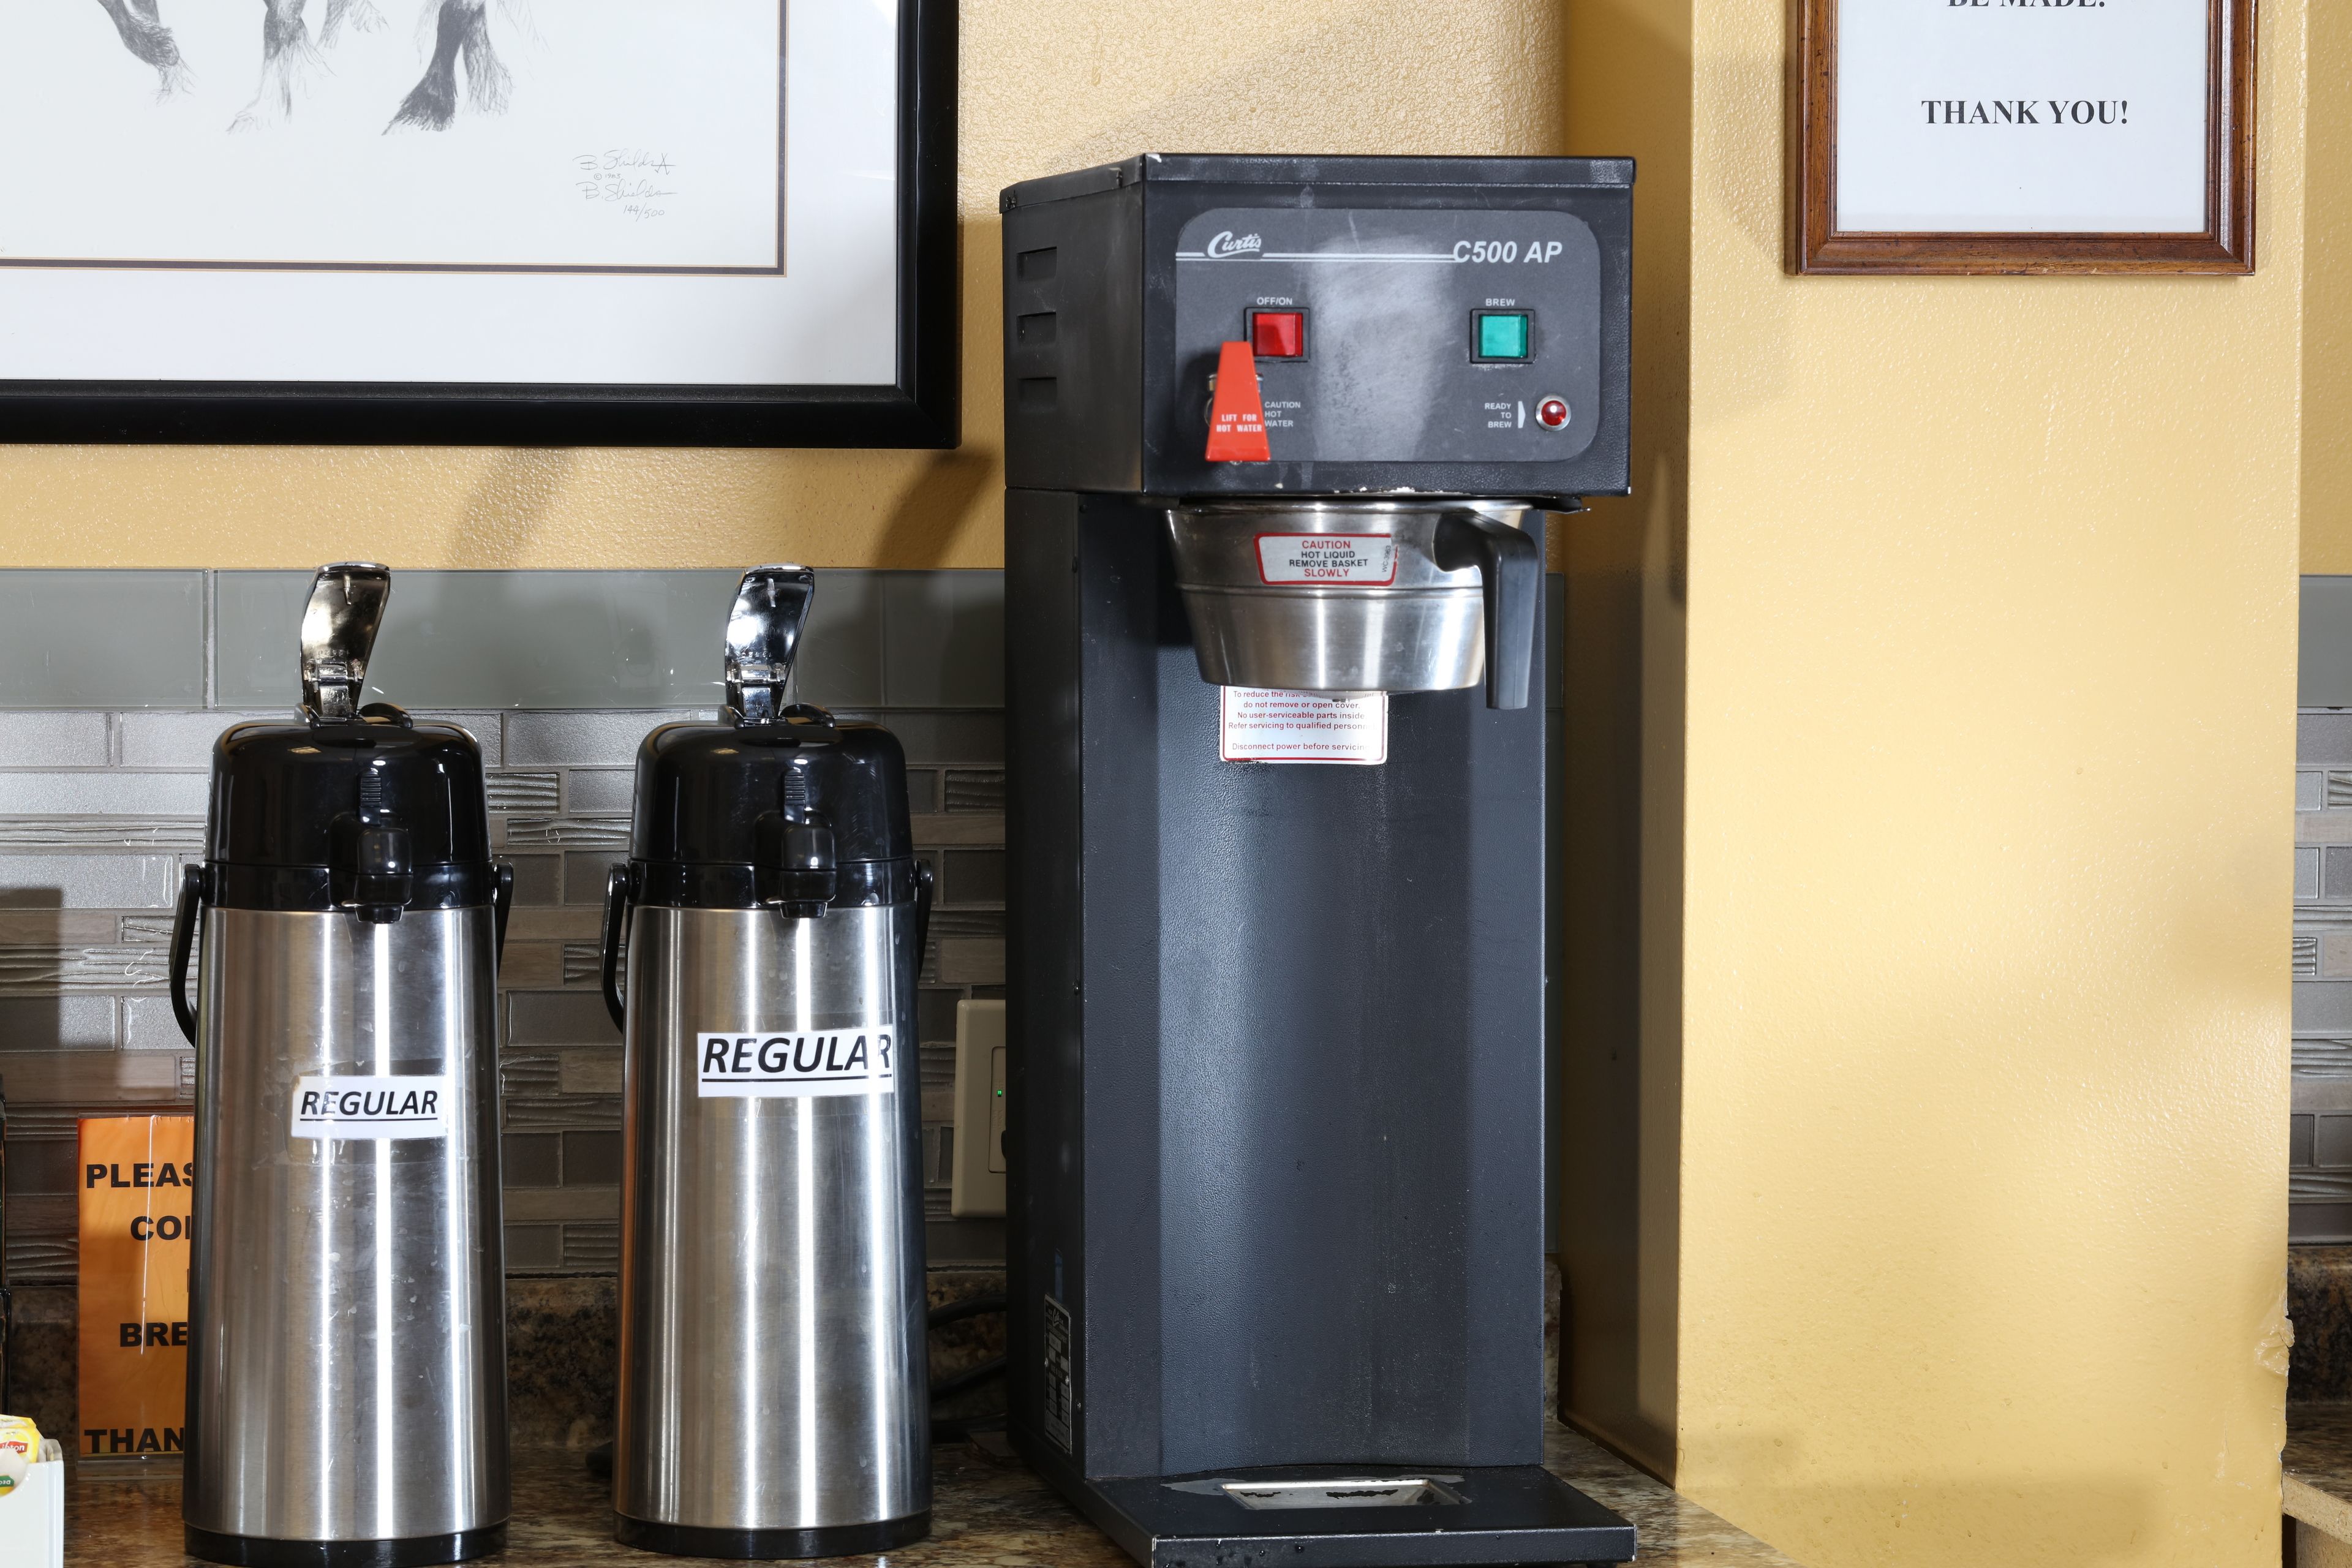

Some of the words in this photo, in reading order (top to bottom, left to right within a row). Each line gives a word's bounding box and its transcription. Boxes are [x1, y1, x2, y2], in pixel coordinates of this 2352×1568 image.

[1921, 100, 2041, 124] THANK
[2047, 100, 2128, 124] YOU!
[1207, 230, 1262, 258] Curtis
[1453, 240, 1518, 263] C500
[1523, 241, 1562, 263] AP
[1256, 296, 1293, 306] OFF/ON
[1485, 298, 1515, 306] BREW
[1242, 413, 1257, 422] FOR
[1236, 424, 1262, 432] WATER
[1302, 540, 1351, 549] CAUTION
[1324, 551, 1355, 559] LIQUID
[1332, 559, 1368, 567] BASKET
[1304, 568, 1350, 577] SLOWLY
[1316, 712, 1337, 720] parts
[1249, 722, 1284, 731] servicing
[1296, 722, 1332, 731] qualified
[1276, 744, 1301, 753] power
[1303, 742, 1330, 751] before
[703, 1033, 892, 1073] REGULAR
[300, 1090, 439, 1116] REGULAR
